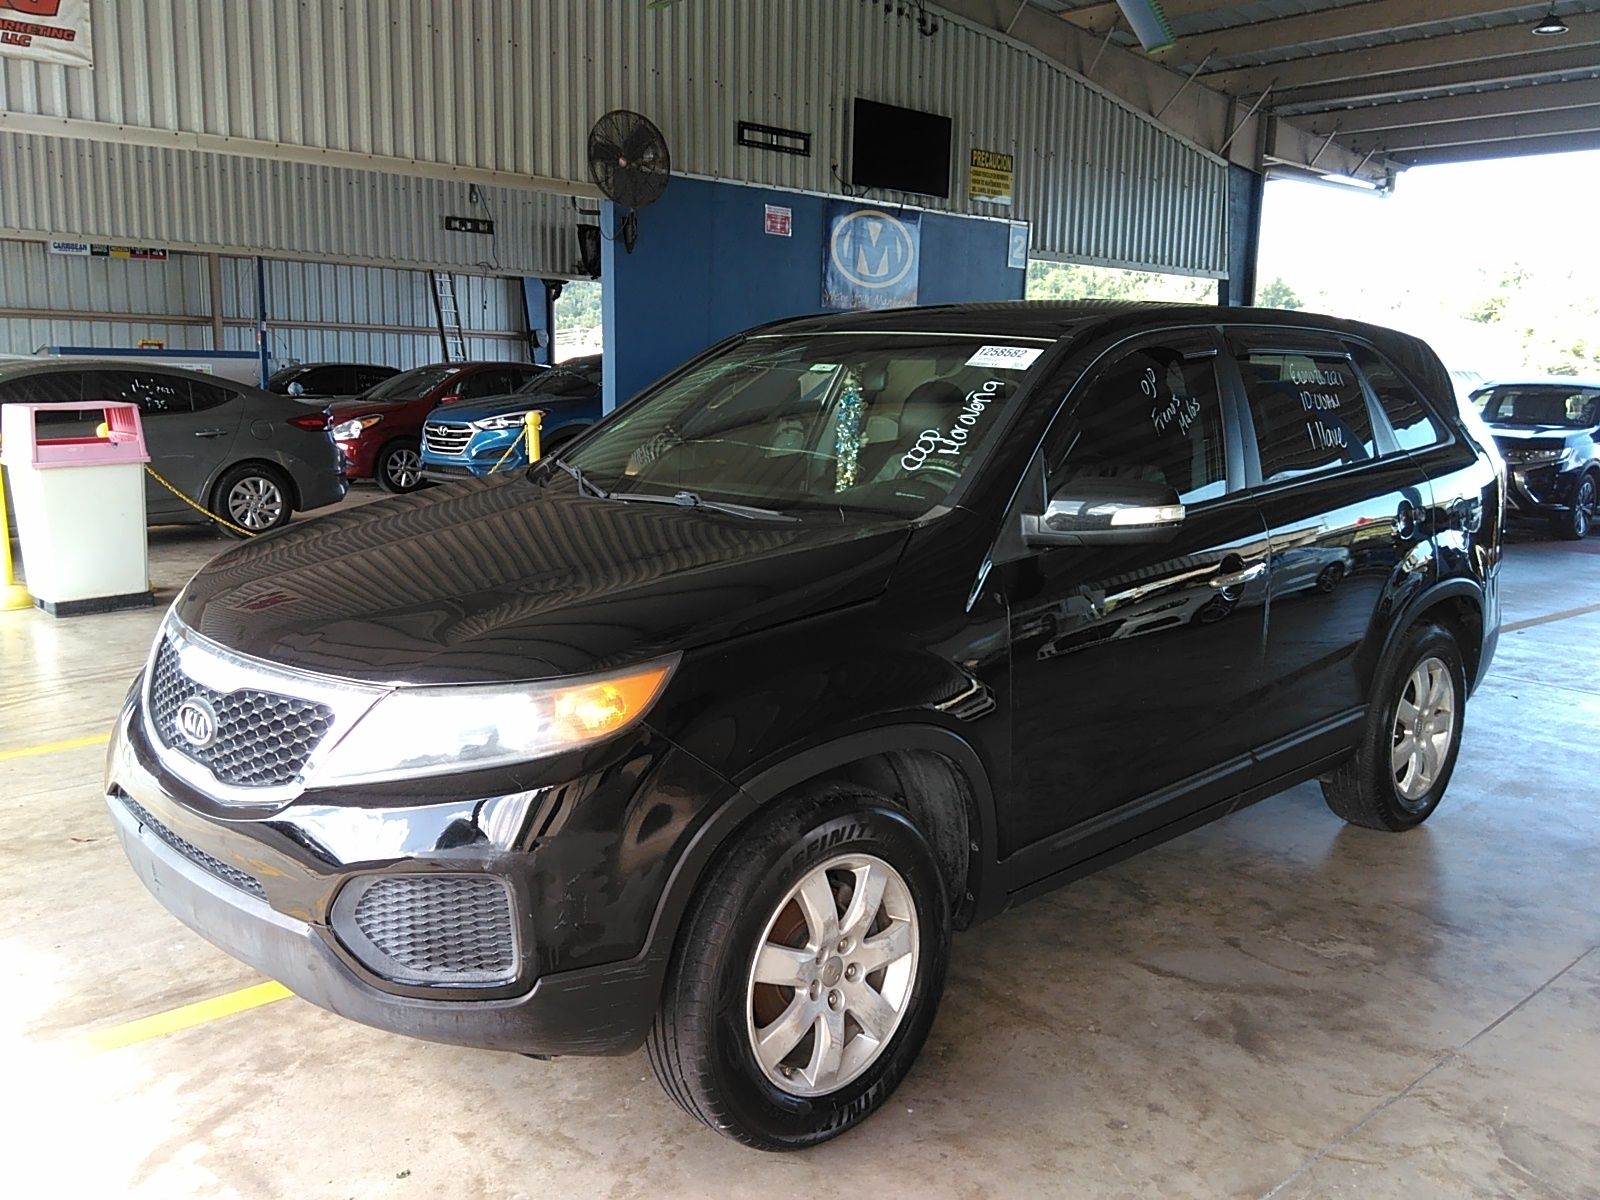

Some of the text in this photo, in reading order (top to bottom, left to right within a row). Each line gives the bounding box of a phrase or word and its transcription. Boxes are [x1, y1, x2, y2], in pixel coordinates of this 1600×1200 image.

[0, 19, 76, 41] RKETING
[1, 32, 31, 47] LLC
[52, 241, 88, 251] CARIBBEAN
[1013, 235, 1025, 259] 2
[978, 347, 1028, 358] 1258582
